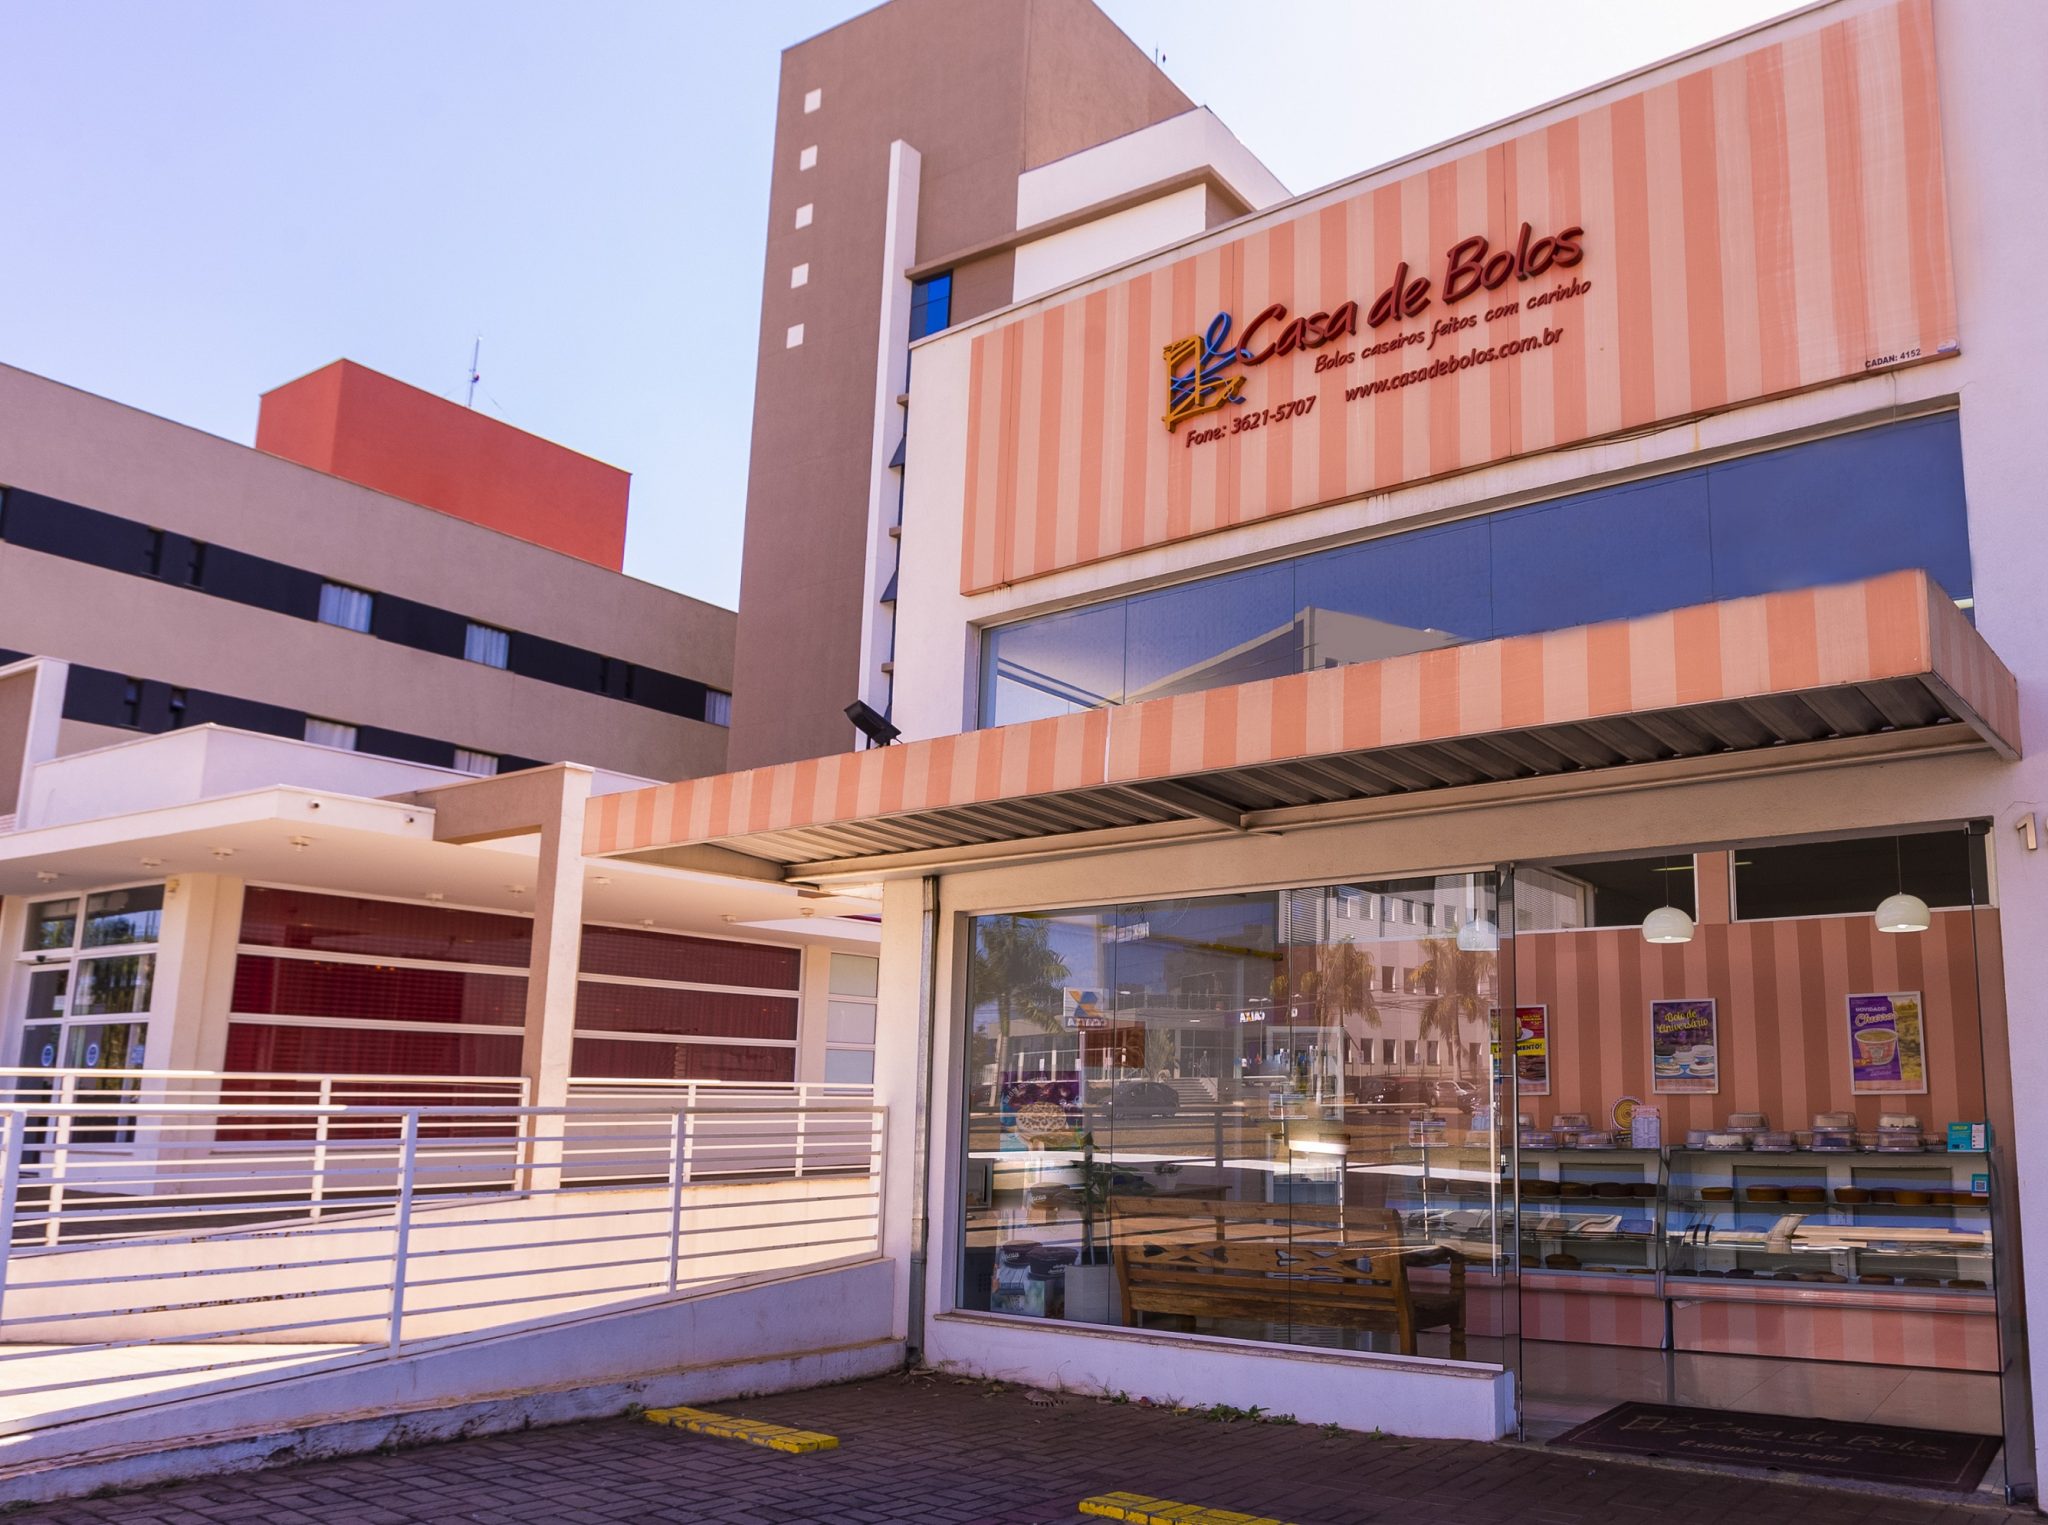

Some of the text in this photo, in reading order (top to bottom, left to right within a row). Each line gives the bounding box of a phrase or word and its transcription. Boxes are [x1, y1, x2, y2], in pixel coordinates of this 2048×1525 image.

[1236, 222, 1584, 366] Casa de Bolos
[1314, 277, 1592, 374] Bolos caseiros feitos com carinho
[1344, 328, 1564, 402] www.casadebolos.com.br
[1865, 348, 1922, 368] CADAN: 4152
[1186, 395, 1317, 448] Fone: 3621-5707
